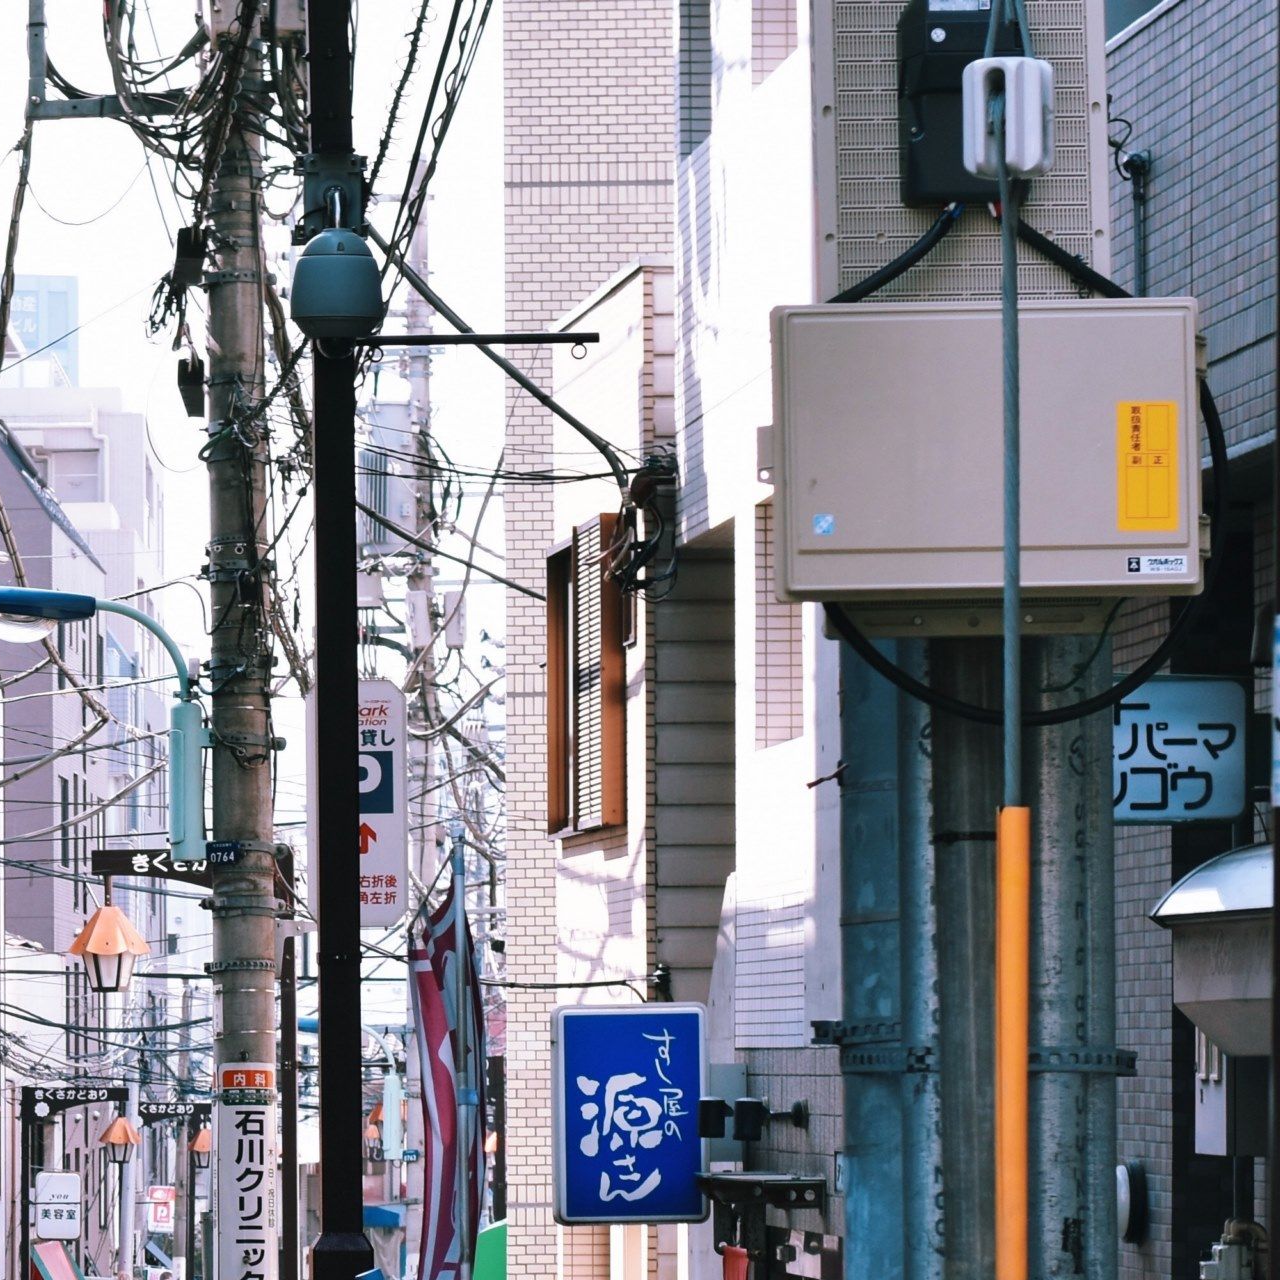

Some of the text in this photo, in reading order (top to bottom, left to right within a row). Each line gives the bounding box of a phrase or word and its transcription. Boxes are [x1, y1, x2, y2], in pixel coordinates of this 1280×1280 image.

[358, 704, 389, 716] ark
[360, 729, 396, 747] 貸し
[210, 852, 235, 862] 0764
[233, 1072, 266, 1087] 内科
[642, 1028, 689, 1142] すし屋の
[140, 1104, 195, 1115] くさかどおり
[41, 1208, 77, 1219] 美容室
